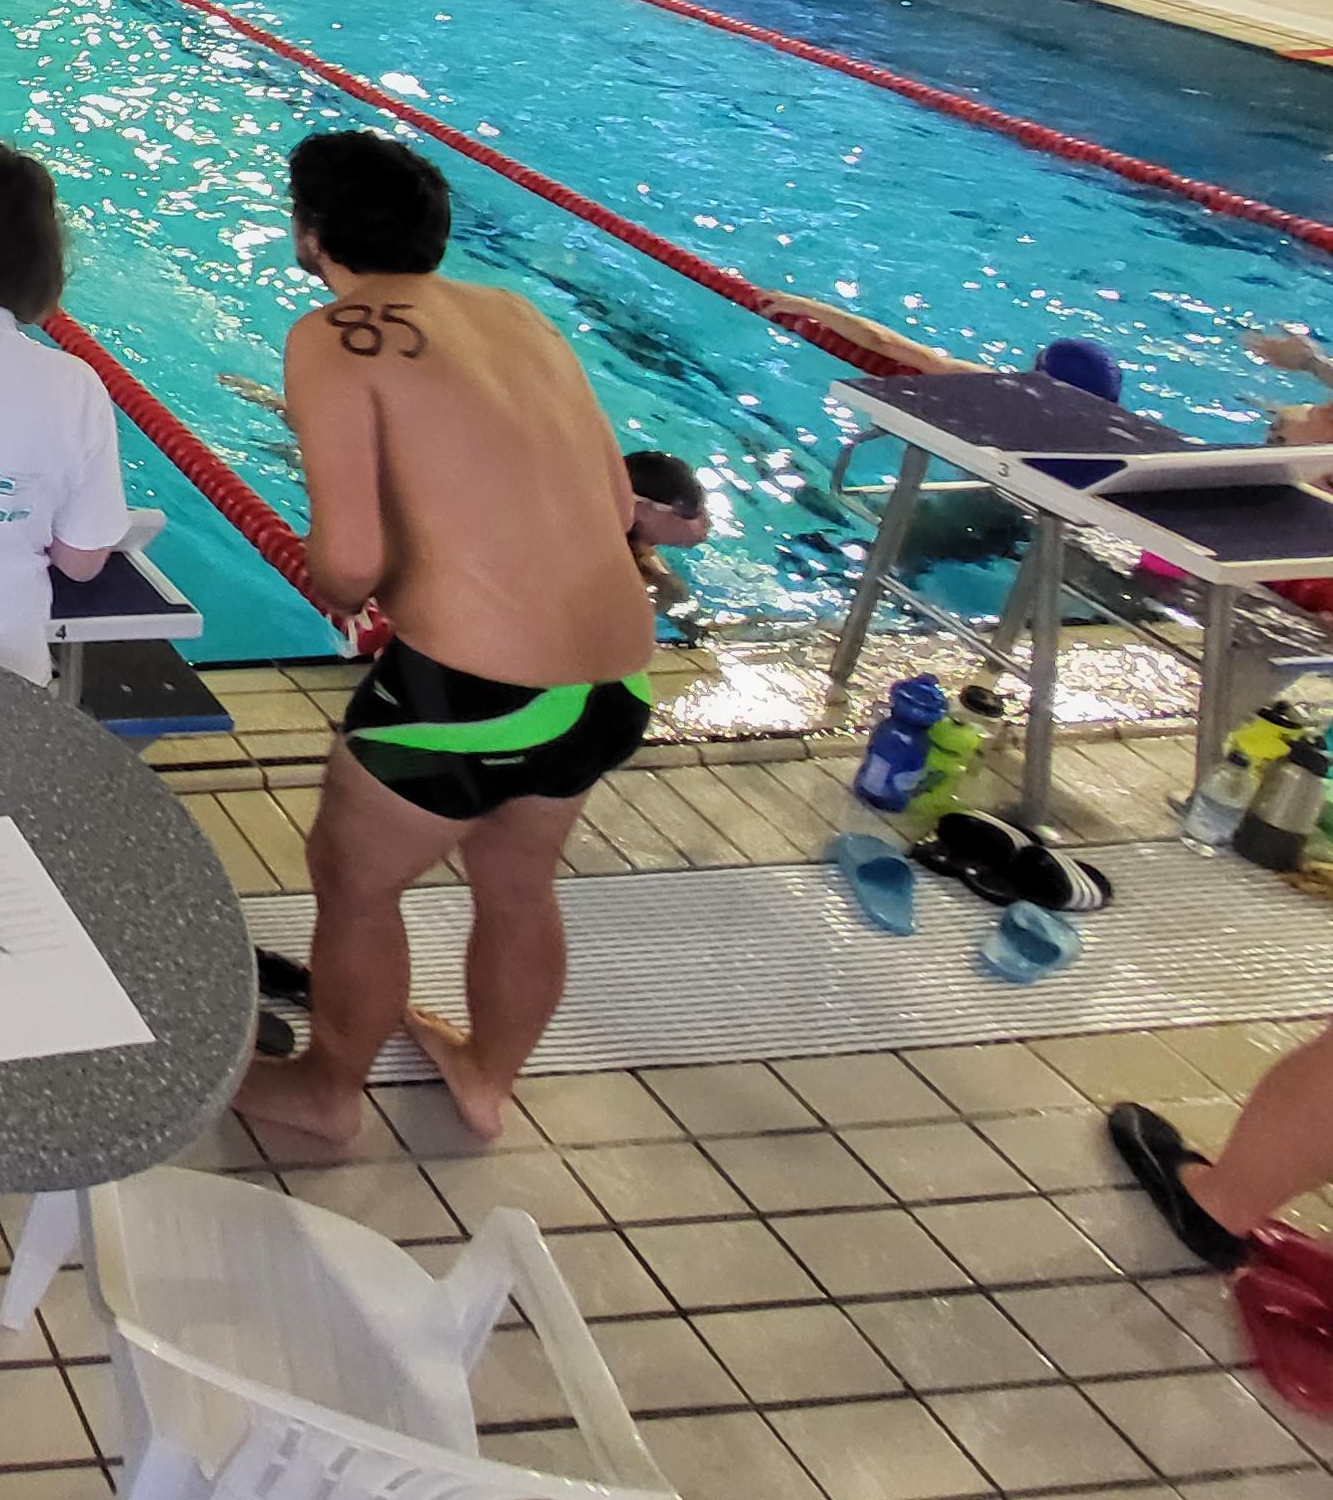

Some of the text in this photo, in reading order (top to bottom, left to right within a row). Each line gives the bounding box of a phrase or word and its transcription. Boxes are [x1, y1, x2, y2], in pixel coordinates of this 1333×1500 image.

[326, 304, 426, 358] 85
[997, 462, 1010, 478] 3
[55, 624, 67, 640] 4
